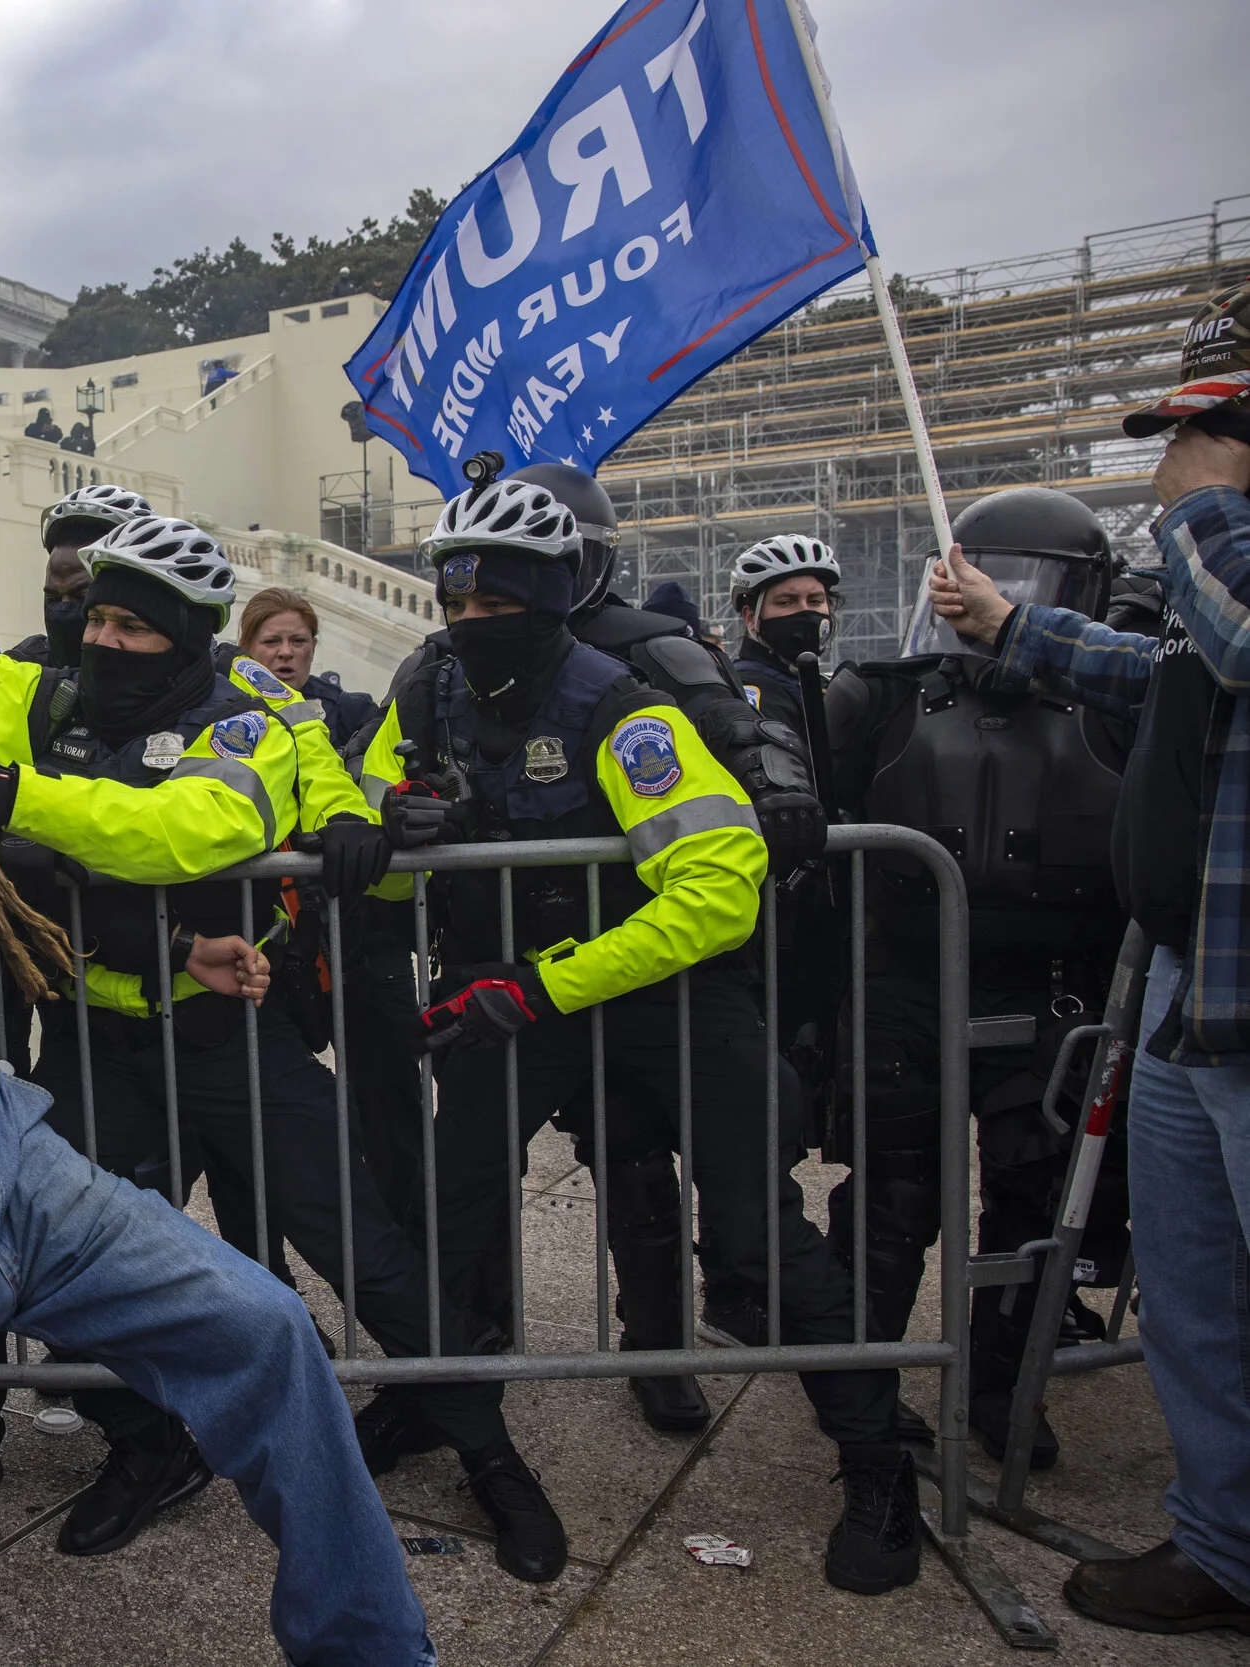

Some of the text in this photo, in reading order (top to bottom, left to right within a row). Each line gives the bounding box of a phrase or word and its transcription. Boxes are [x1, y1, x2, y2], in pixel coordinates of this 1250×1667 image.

[1183, 317, 1235, 346] UMP
[1201, 351, 1231, 364] GREAT!
[614, 722, 670, 751] METROPOLITAN POLICE
[63, 744, 87, 758] TORAN
